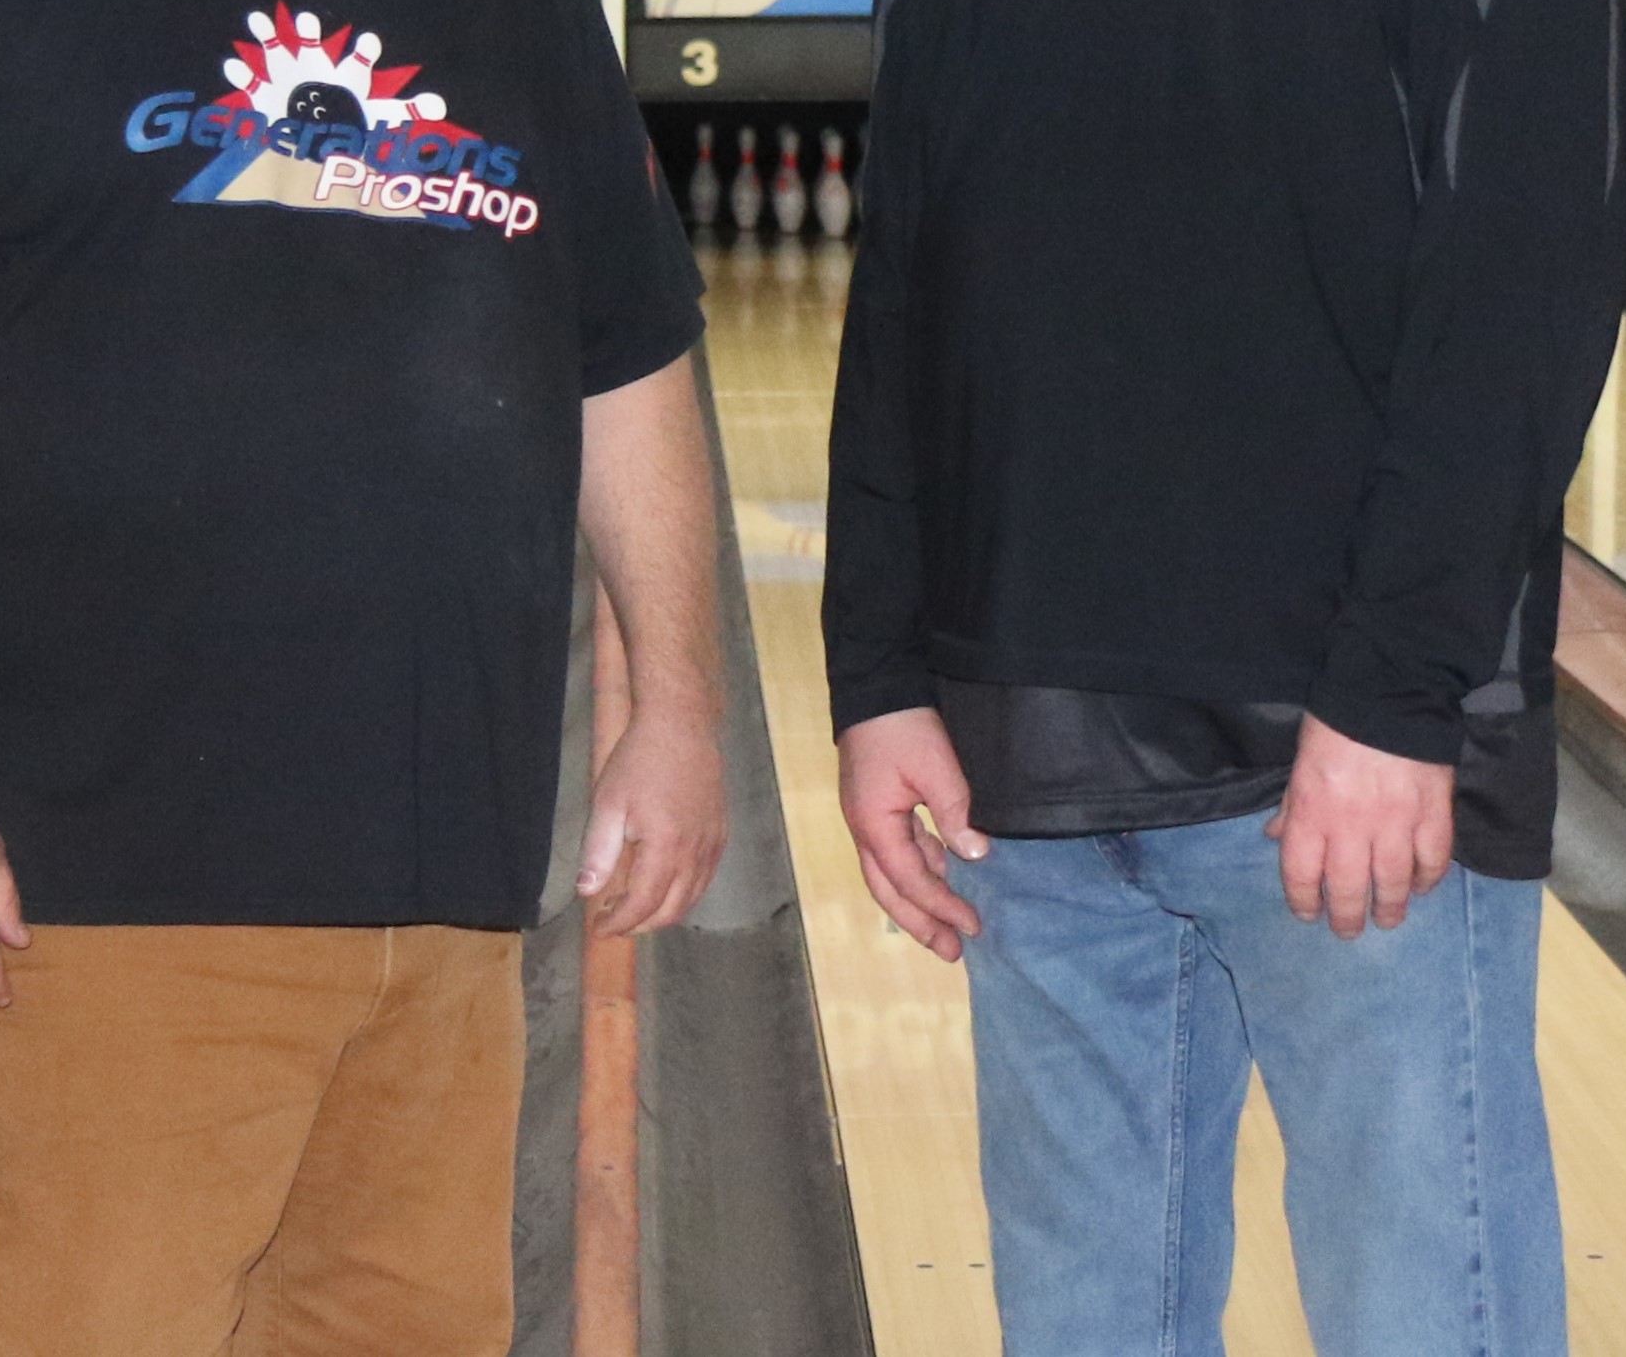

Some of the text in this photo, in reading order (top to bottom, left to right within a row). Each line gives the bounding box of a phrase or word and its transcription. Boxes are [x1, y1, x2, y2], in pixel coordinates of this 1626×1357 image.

[681, 39, 720, 87] 3
[125, 90, 523, 188] Generations
[314, 154, 538, 238] Proshop
